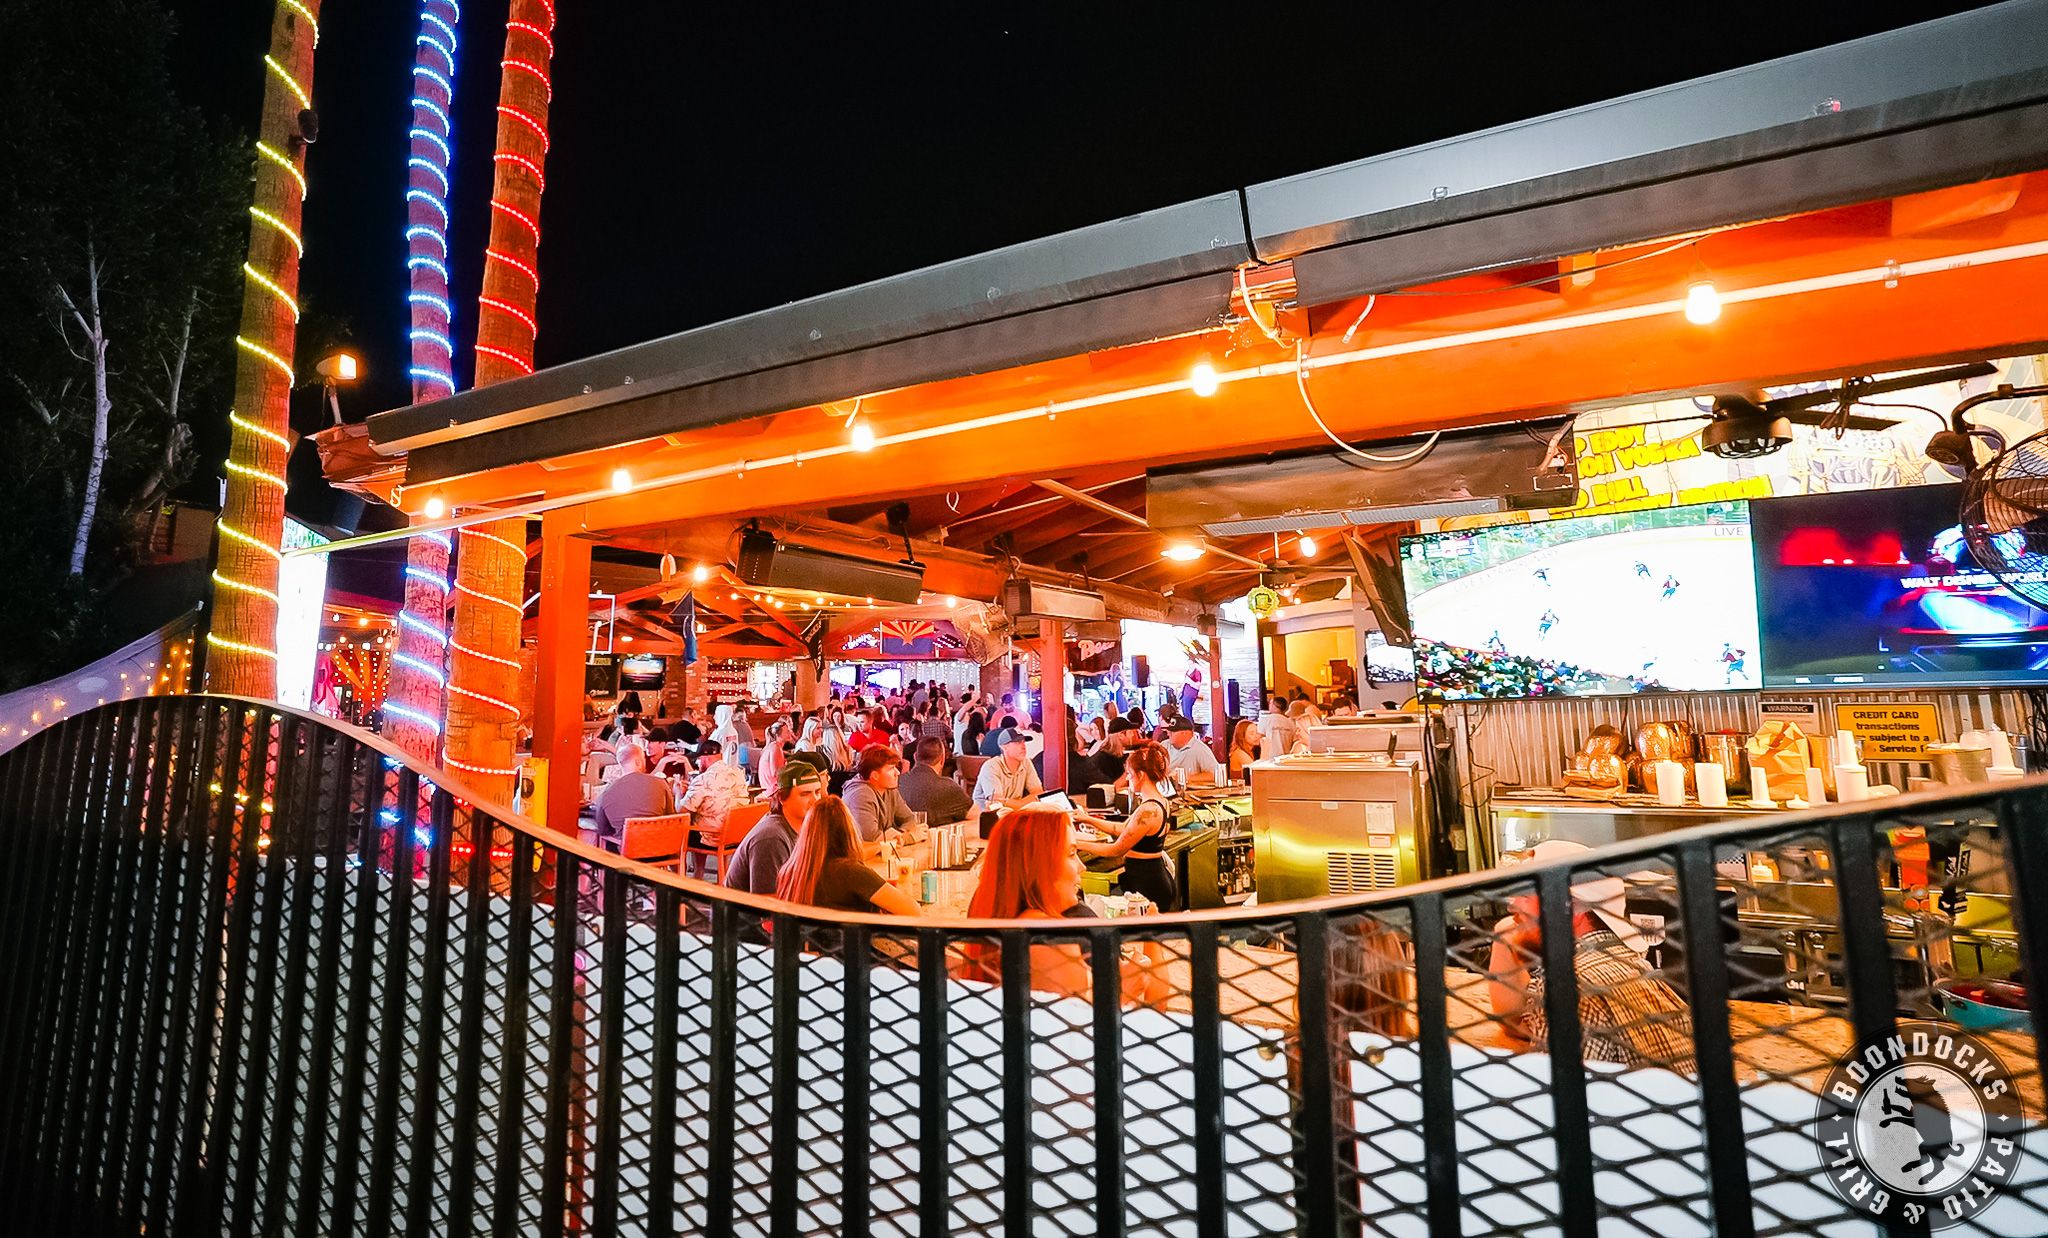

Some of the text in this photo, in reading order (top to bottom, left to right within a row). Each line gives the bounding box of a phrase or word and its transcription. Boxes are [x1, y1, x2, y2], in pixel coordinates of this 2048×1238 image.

[1588, 424, 1647, 454] EDDY
[1615, 437, 1701, 471] VODKA
[1591, 475, 1649, 506] BULL
[1714, 526, 1744, 537] LIVE
[1900, 576, 1941, 589] WALT
[1853, 711, 1919, 719] CREDIT CARD
[1856, 722, 1920, 730] transactions
[1869, 734, 1907, 743] subject
[1910, 734, 1920, 742] to
[1879, 744, 1917, 753] Service
